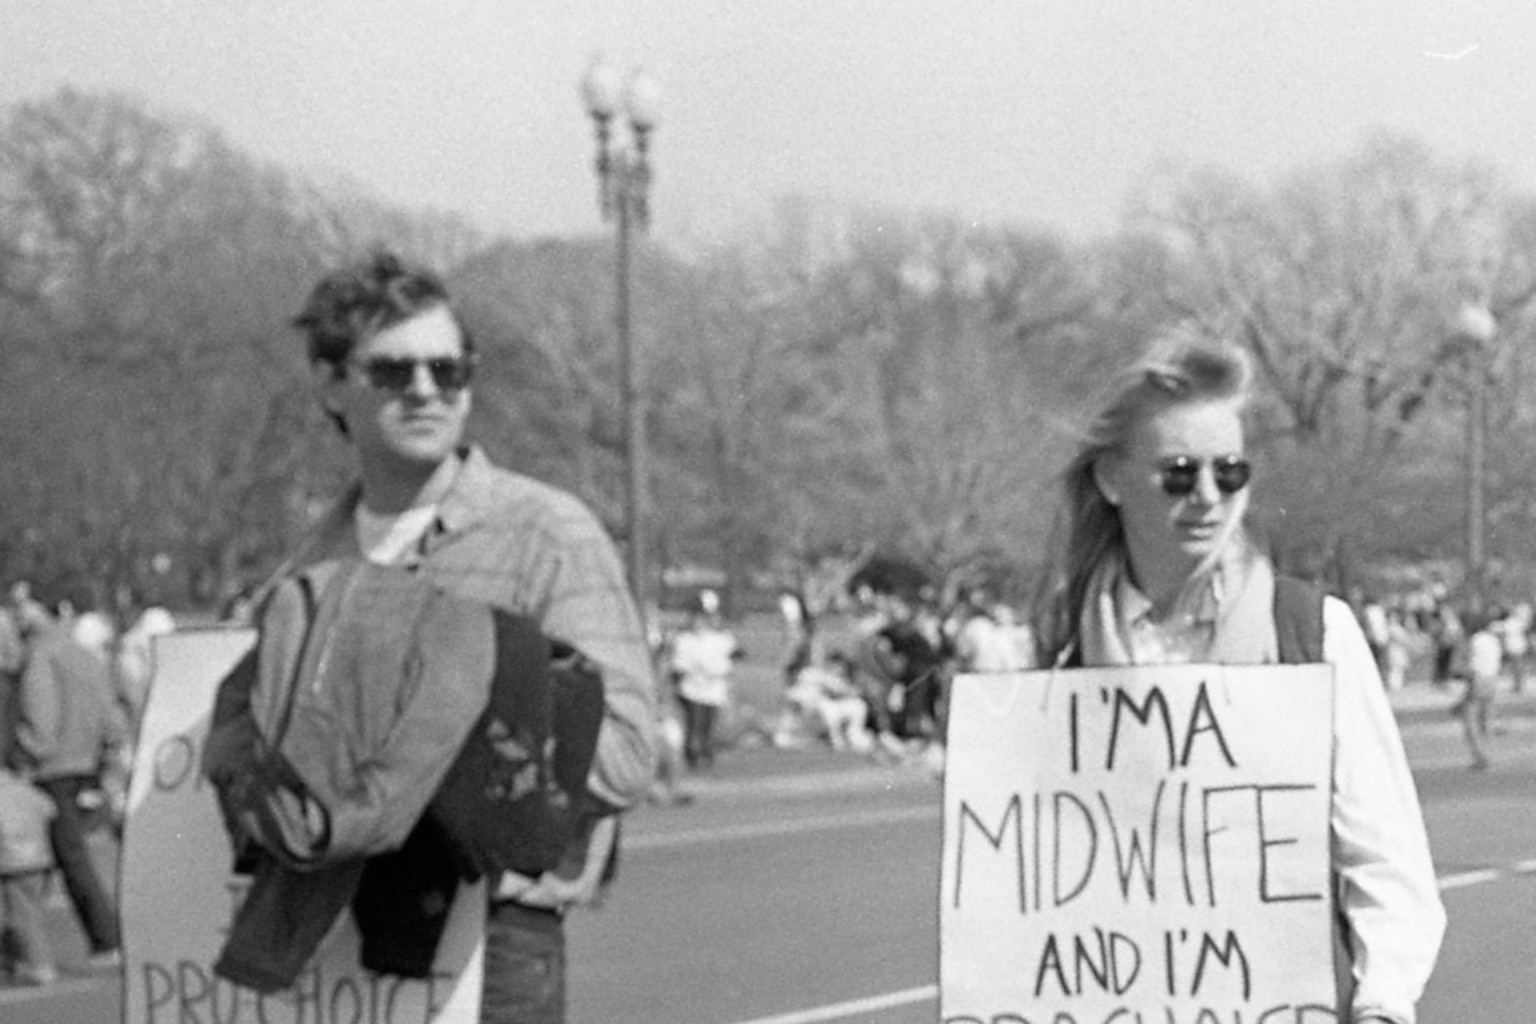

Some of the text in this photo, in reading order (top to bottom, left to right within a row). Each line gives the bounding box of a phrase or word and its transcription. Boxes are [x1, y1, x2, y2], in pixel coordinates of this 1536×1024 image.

[1069, 682, 1237, 773] I'M A
[955, 780, 1323, 914] MIDWIFE
[1035, 926, 1252, 1001] AND I'M
